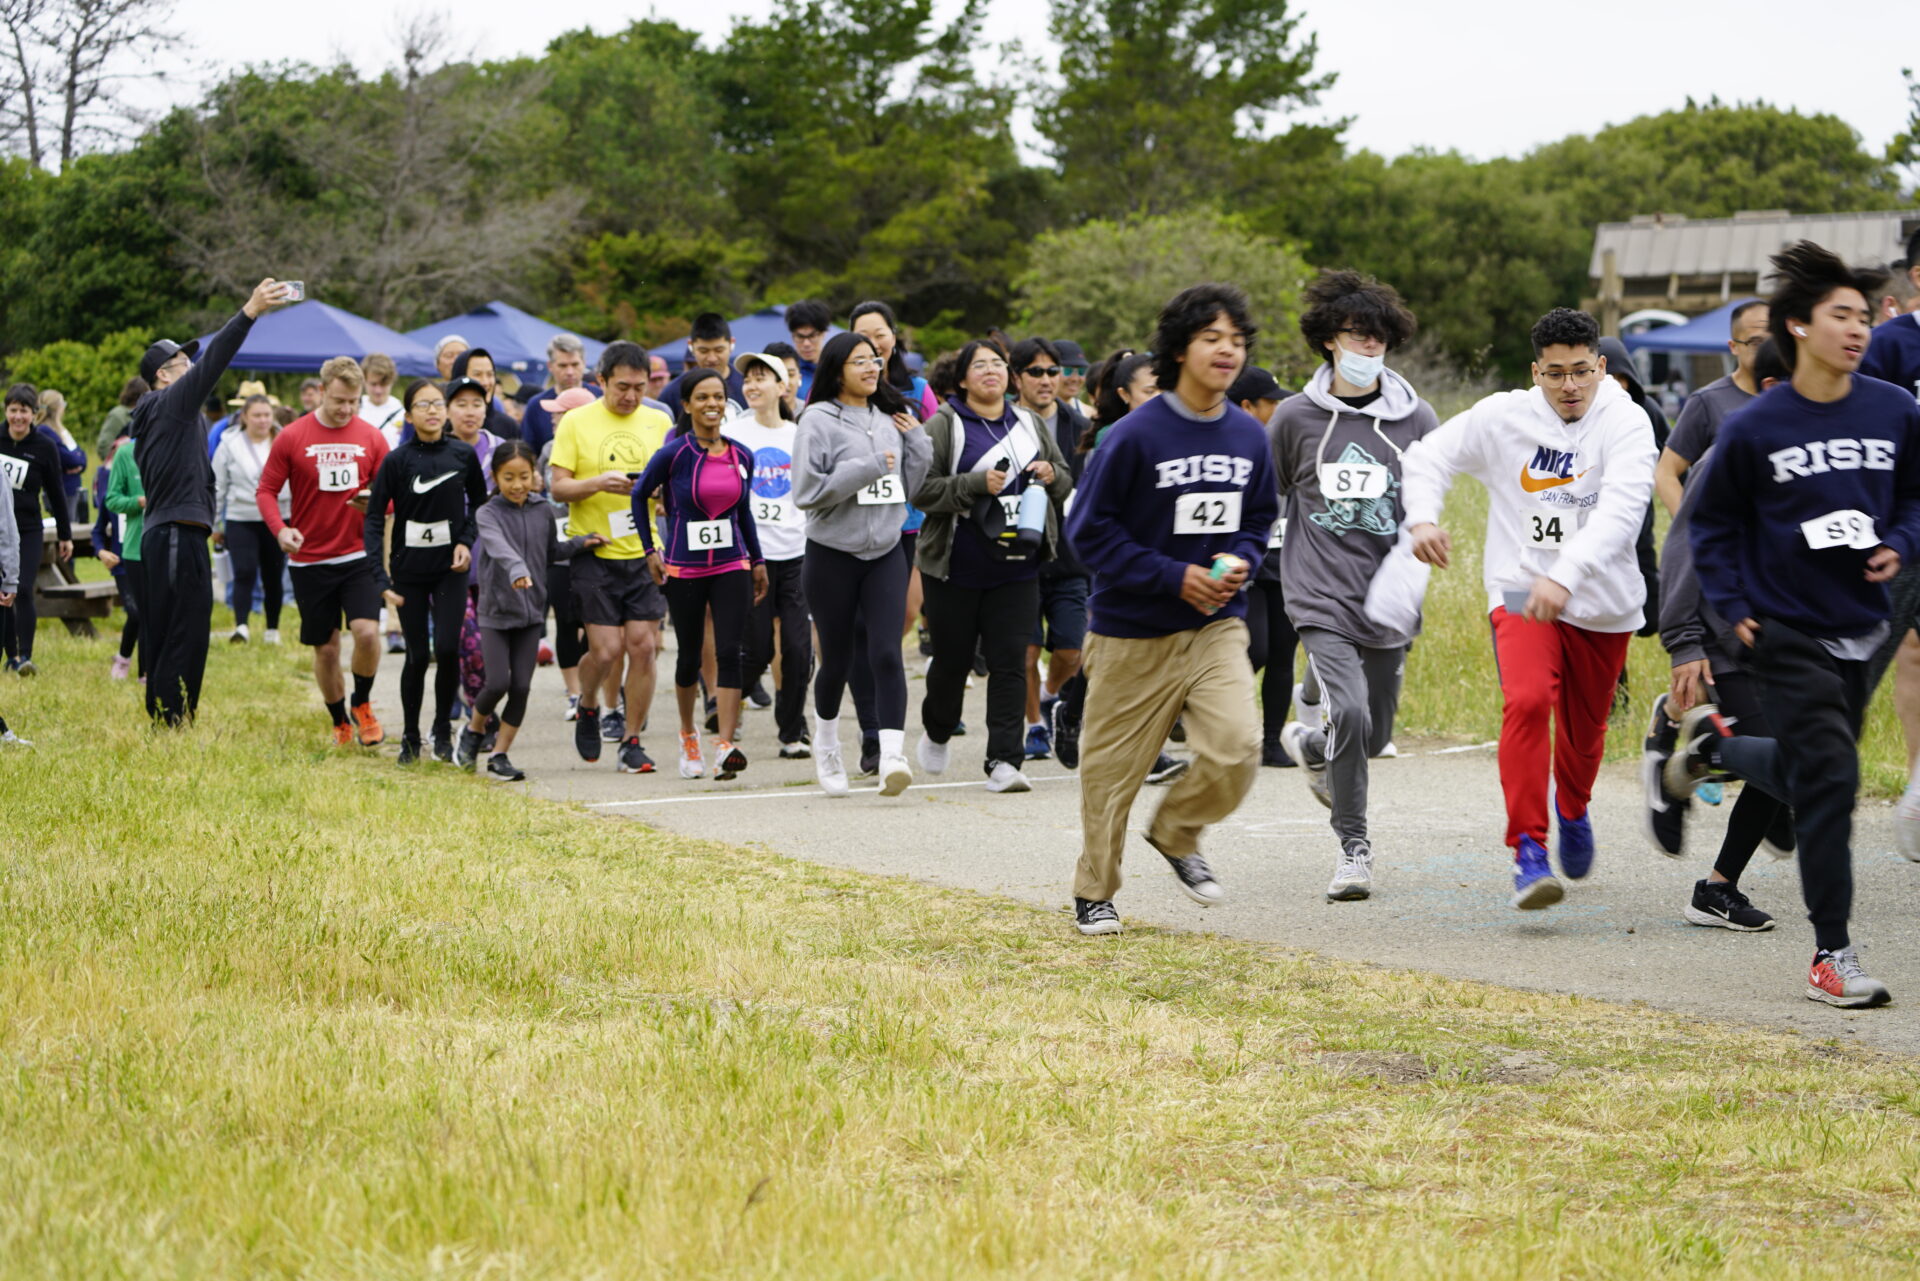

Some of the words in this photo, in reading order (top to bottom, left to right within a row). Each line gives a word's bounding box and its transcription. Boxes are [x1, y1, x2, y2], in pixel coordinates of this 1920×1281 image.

[1530, 445, 1574, 479] NIKE
[1768, 438, 1896, 483] RISE
[329, 469, 351, 486] 10
[1155, 454, 1254, 488] RISE
[1336, 469, 1371, 492] 87
[867, 480, 892, 498] 45
[1540, 490, 1559, 503] SAN
[757, 503, 782, 521] 32
[1191, 500, 1227, 527] 42
[421, 528, 434, 543] 4
[699, 526, 723, 544] 61
[1532, 515, 1564, 543] 34
